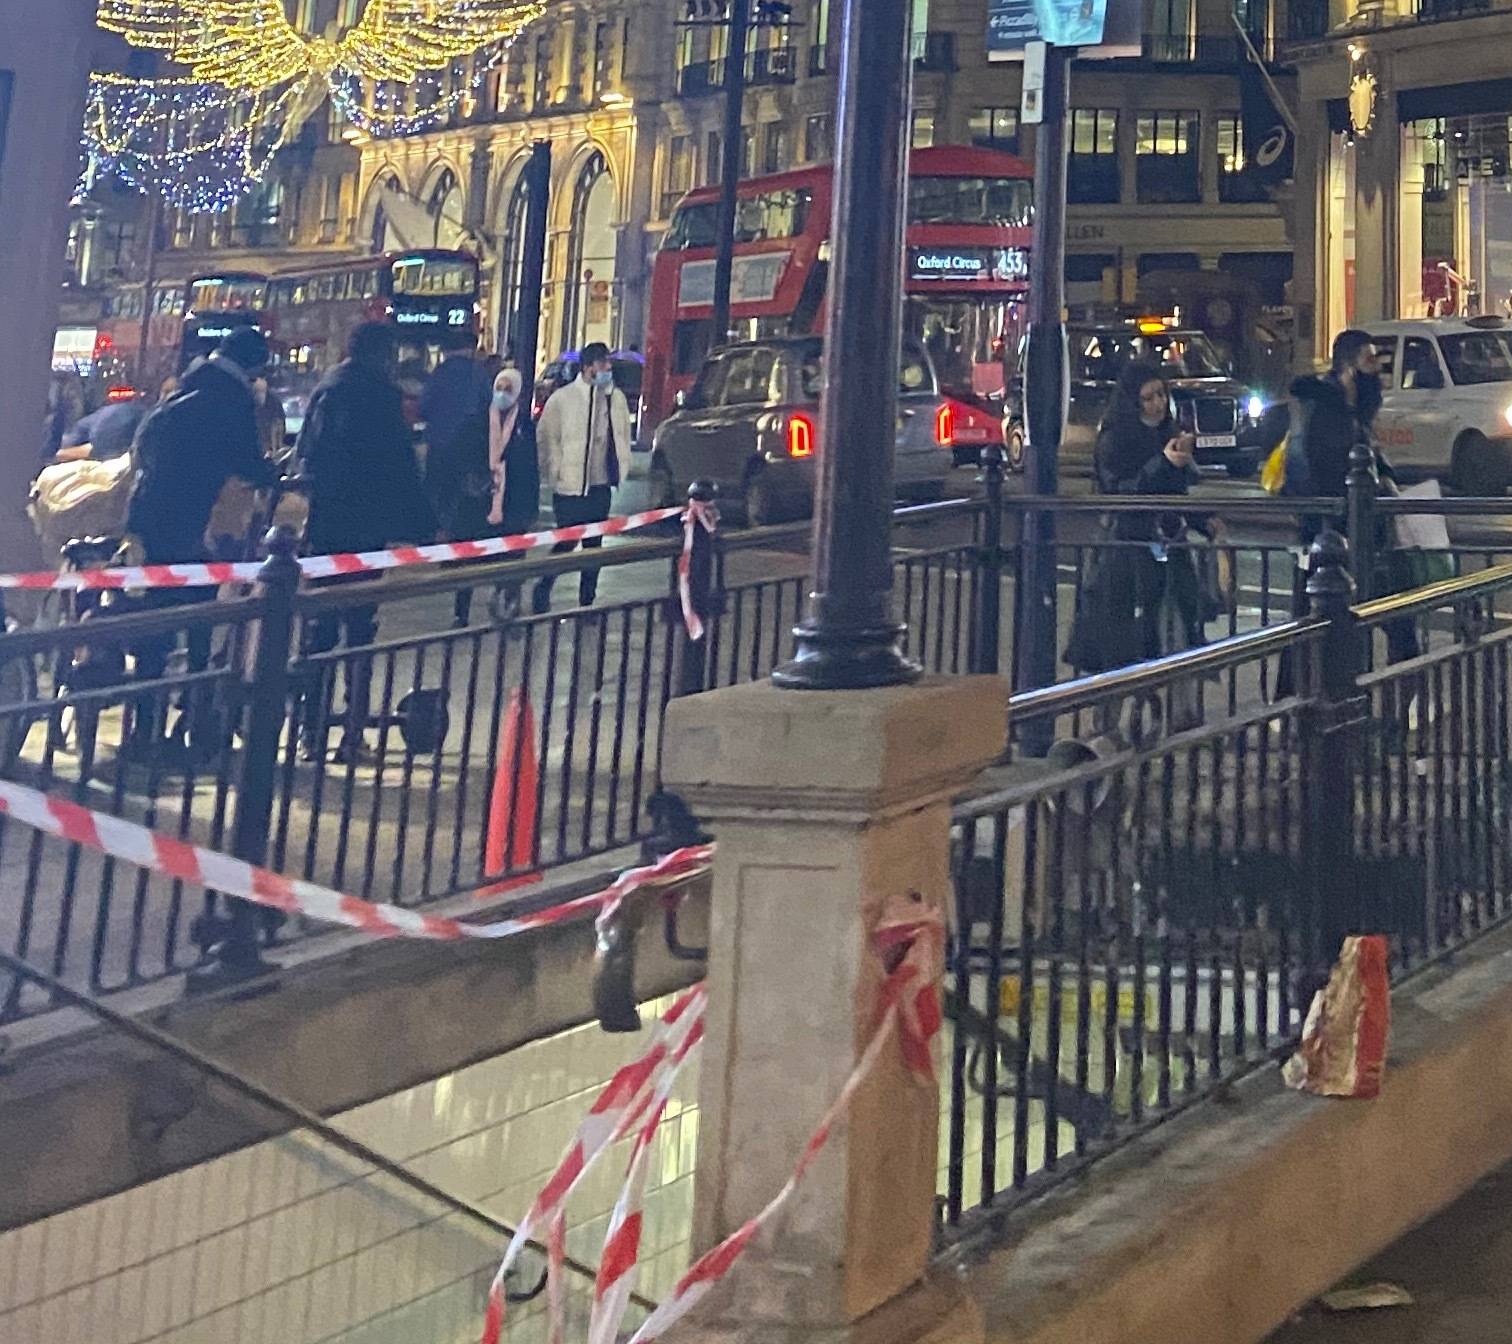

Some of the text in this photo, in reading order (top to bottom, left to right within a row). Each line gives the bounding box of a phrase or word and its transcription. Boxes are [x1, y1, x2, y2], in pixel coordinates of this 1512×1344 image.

[917, 249, 1023, 273] Oxford Circus 453
[448, 310, 465, 324] 22
